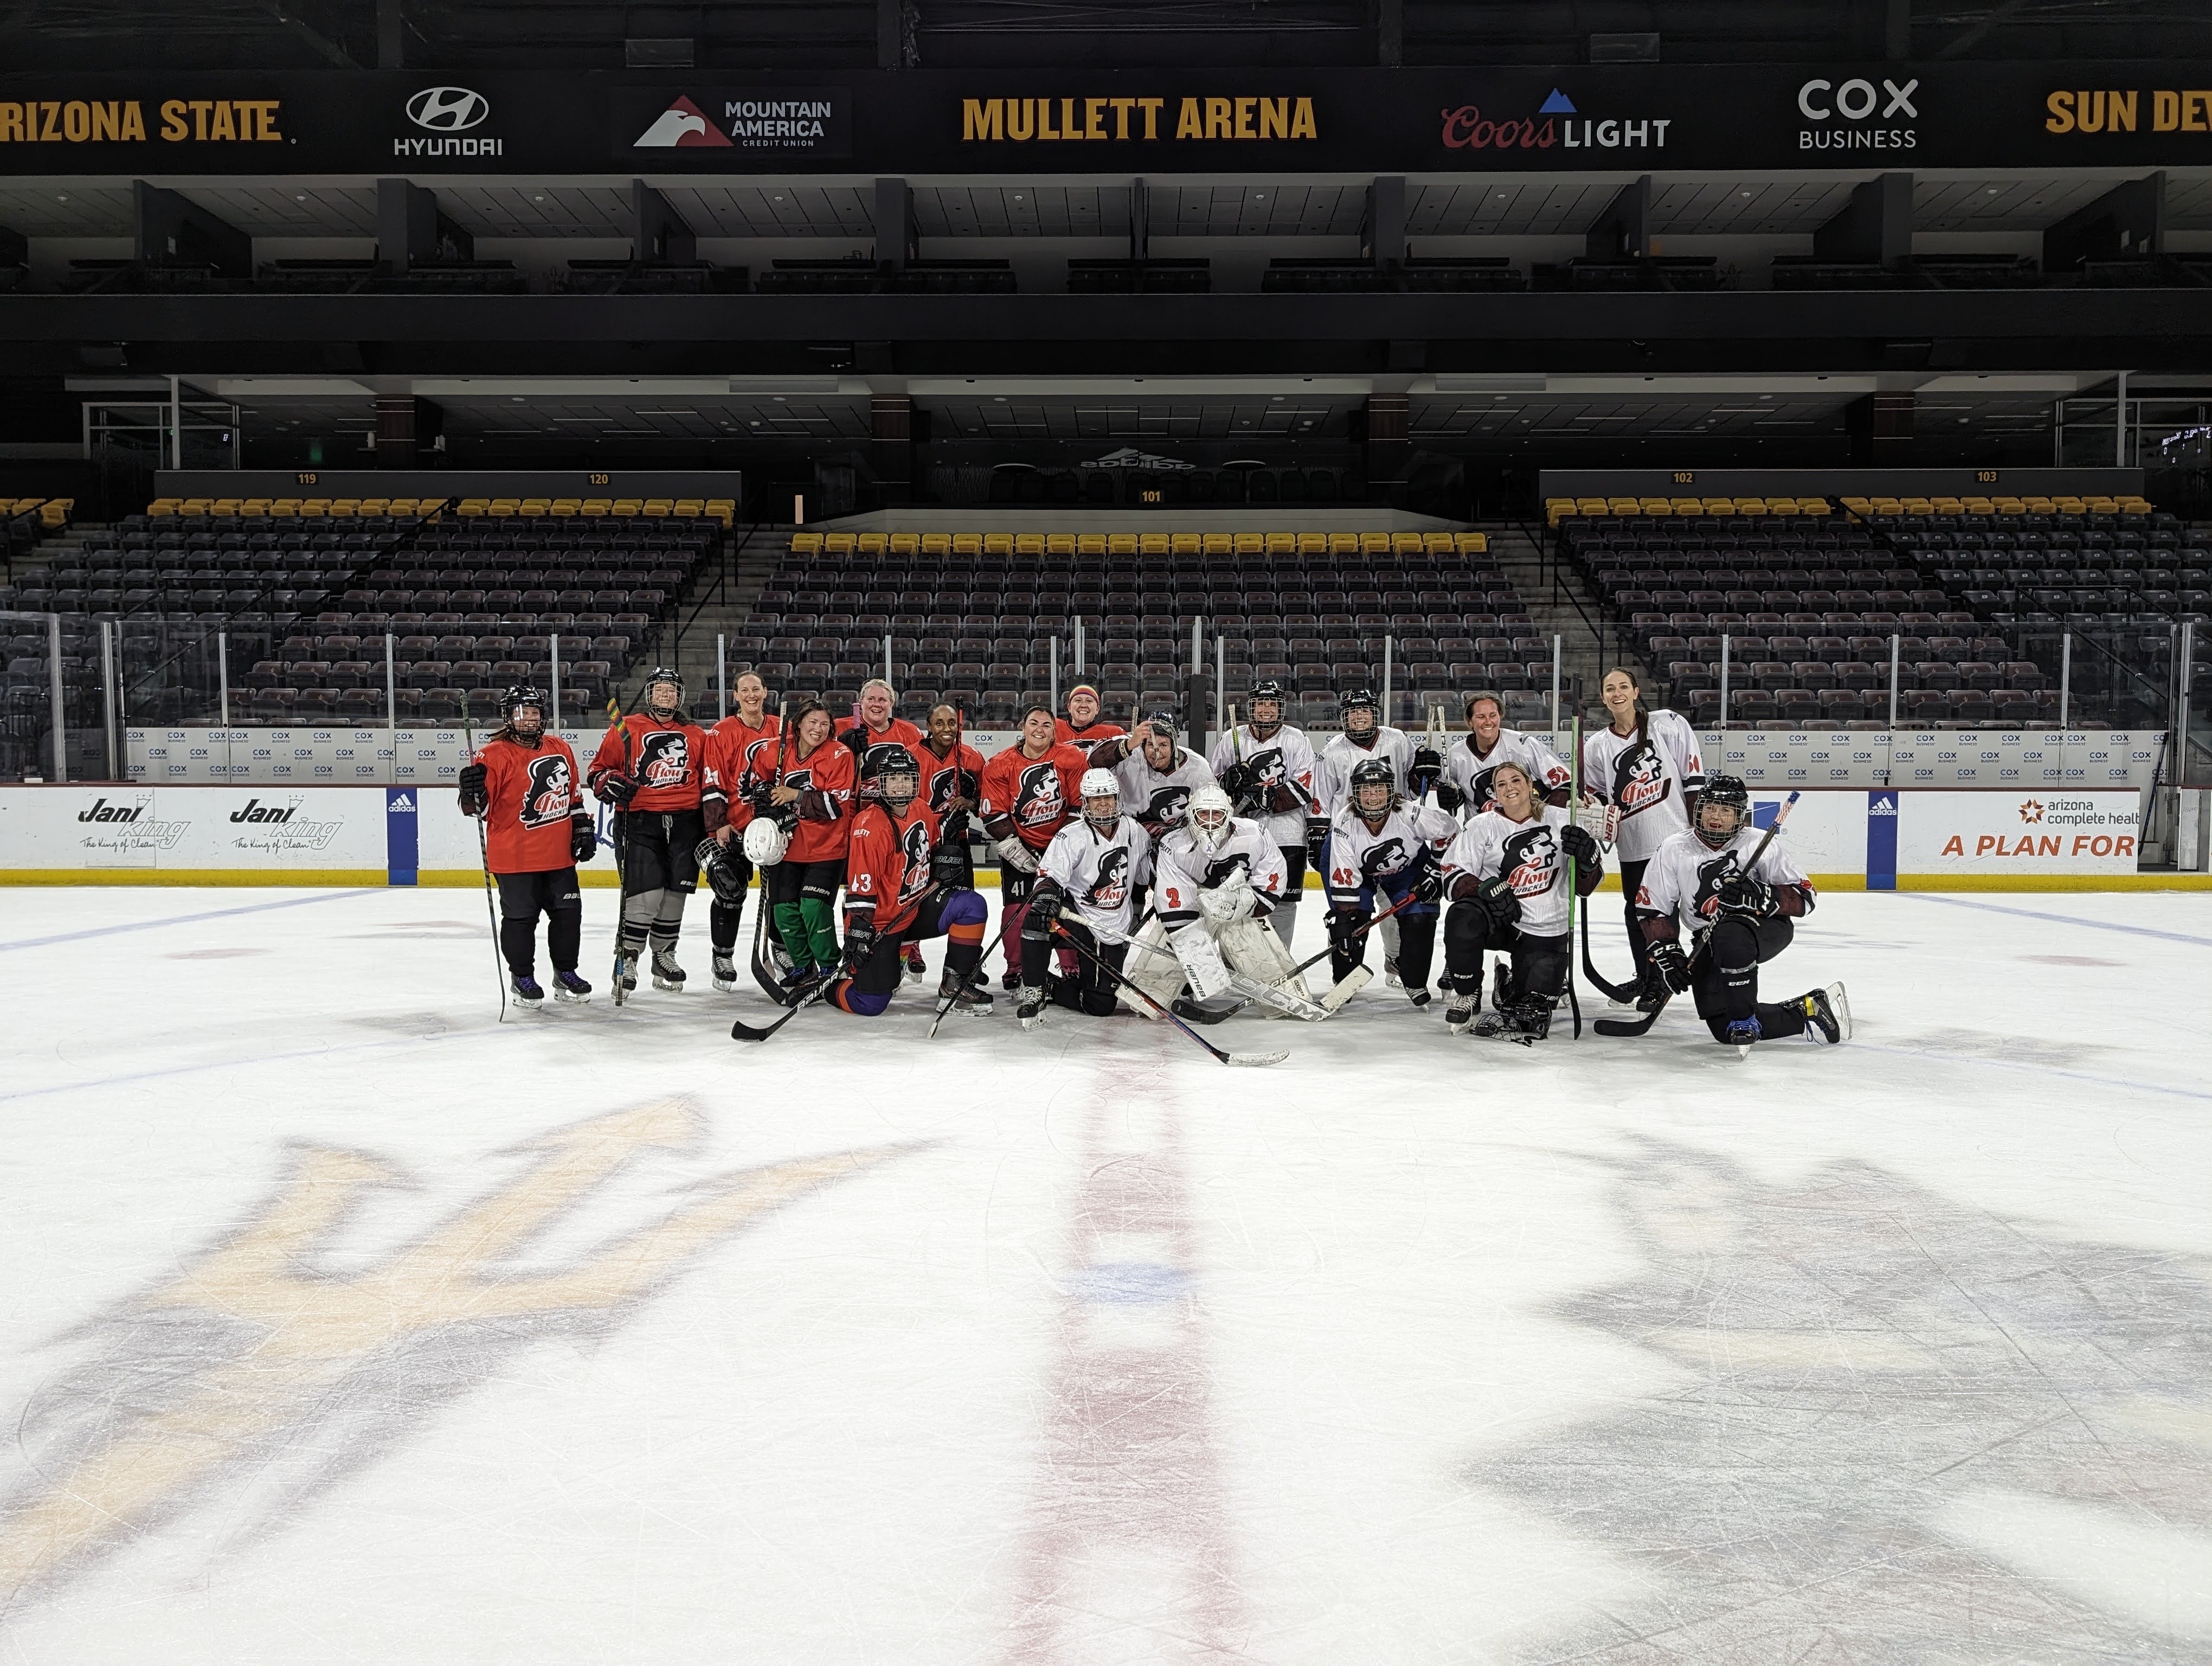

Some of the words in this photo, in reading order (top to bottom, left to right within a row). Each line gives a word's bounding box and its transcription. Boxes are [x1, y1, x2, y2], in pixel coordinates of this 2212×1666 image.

[1798, 79, 1918, 119] COX
[725, 102, 831, 118] MOUNTAIN
[962, 98, 1165, 140] MULLETT
[1175, 97, 1318, 140] ARENA
[2046, 90, 2138, 133] SUN
[160, 100, 282, 142] STATE
[731, 120, 824, 137] AMERICA
[1441, 105, 1558, 149] Coors
[1564, 119, 1671, 147] LIGHT
[394, 138, 502, 156] HYUNDAI
[1799, 130, 1917, 149] BUSINESS
[298, 473, 317, 484] 119
[589, 474, 609, 485] 120
[1674, 472, 1693, 483] 102
[1977, 471, 1997, 482] 103
[1142, 491, 1161, 502] 101
[1622, 772, 1662, 804] Flow
[78, 798, 144, 822] Jani
[1631, 792, 1661, 810] HOCKEY
[2048, 799, 2093, 811] arizona
[230, 799, 297, 823] Jani
[1030, 812, 1058, 823] HOCKEY
[2047, 812, 2105, 826] complete
[117, 816, 191, 849] king
[1604, 806, 1616, 841] AUER
[269, 817, 344, 850] king
[80, 837, 97, 848] The
[98, 837, 118, 853] King
[120, 838, 129, 854] of
[131, 837, 155, 848] Clean
[232, 837, 248, 848] The
[250, 838, 270, 853] King
[272, 838, 281, 854] of
[283, 838, 309, 849] Clean
[1941, 835, 1964, 856] A
[1976, 835, 2062, 856] PLAN
[2071, 835, 2135, 856] FOR
[1332, 867, 1353, 886] 43
[1508, 857, 1549, 887] Flow
[802, 885, 831, 896] BAUER
[1011, 880, 1025, 897] 41
[1267, 873, 1279, 892] 2
[1516, 880, 1549, 894] HOCKEY
[1166, 887, 1181, 909] 2
[847, 928, 872, 940] UER
[1186, 964, 1207, 998] BAUER
[797, 972, 839, 1013] BAUER
